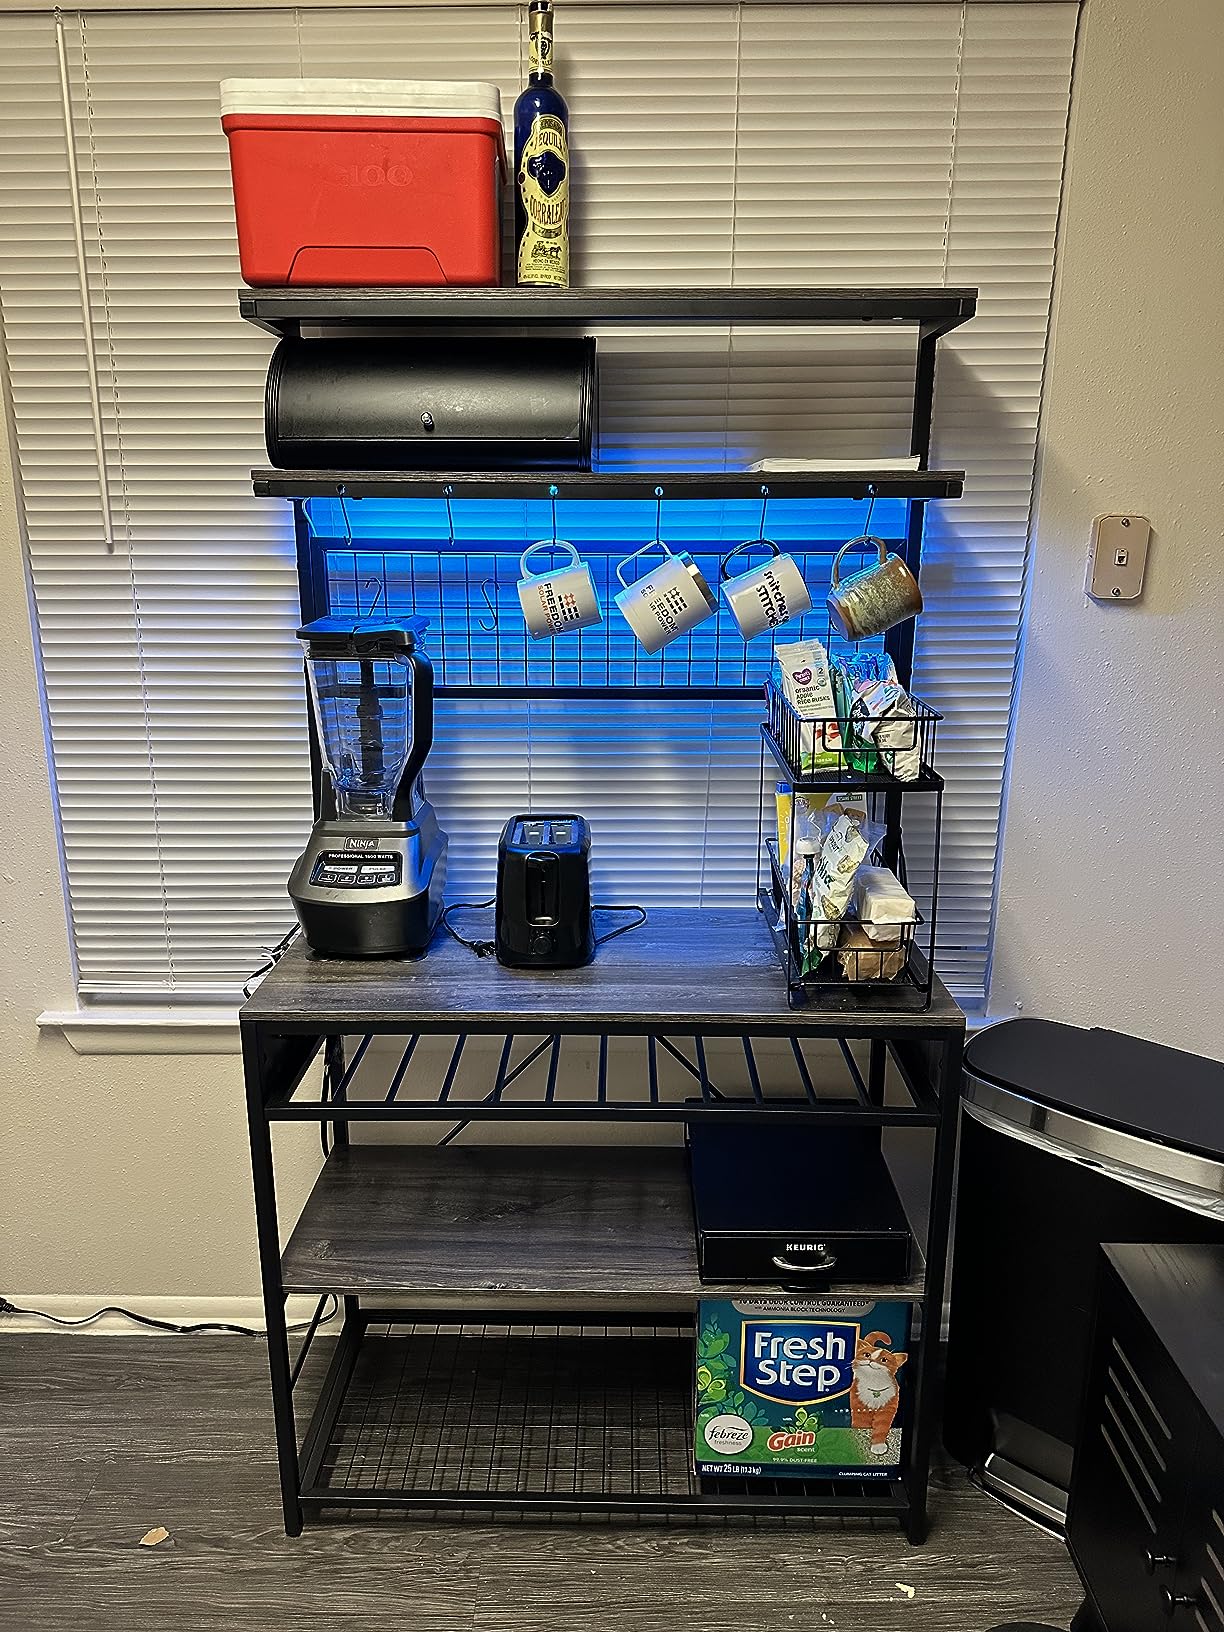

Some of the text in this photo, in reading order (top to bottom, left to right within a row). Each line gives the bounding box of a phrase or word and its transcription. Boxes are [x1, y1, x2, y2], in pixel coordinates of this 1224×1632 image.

[537, 585, 557, 635] SOLAR POWE
[645, 584, 680, 633] FEEDOM
[349, 838, 375, 850] NINJA
[785, 1243, 824, 1252] KEURIG
[754, 1331, 846, 1360] Fresh
[755, 1359, 841, 1392] Step
[709, 1425, 750, 1441] febreze
[768, 1430, 816, 1451] Gain
[701, 1464, 713, 1473] NET
[713, 1465, 723, 1473] WT
[723, 1463, 732, 1473] 25
[732, 1465, 740, 1474] LB
